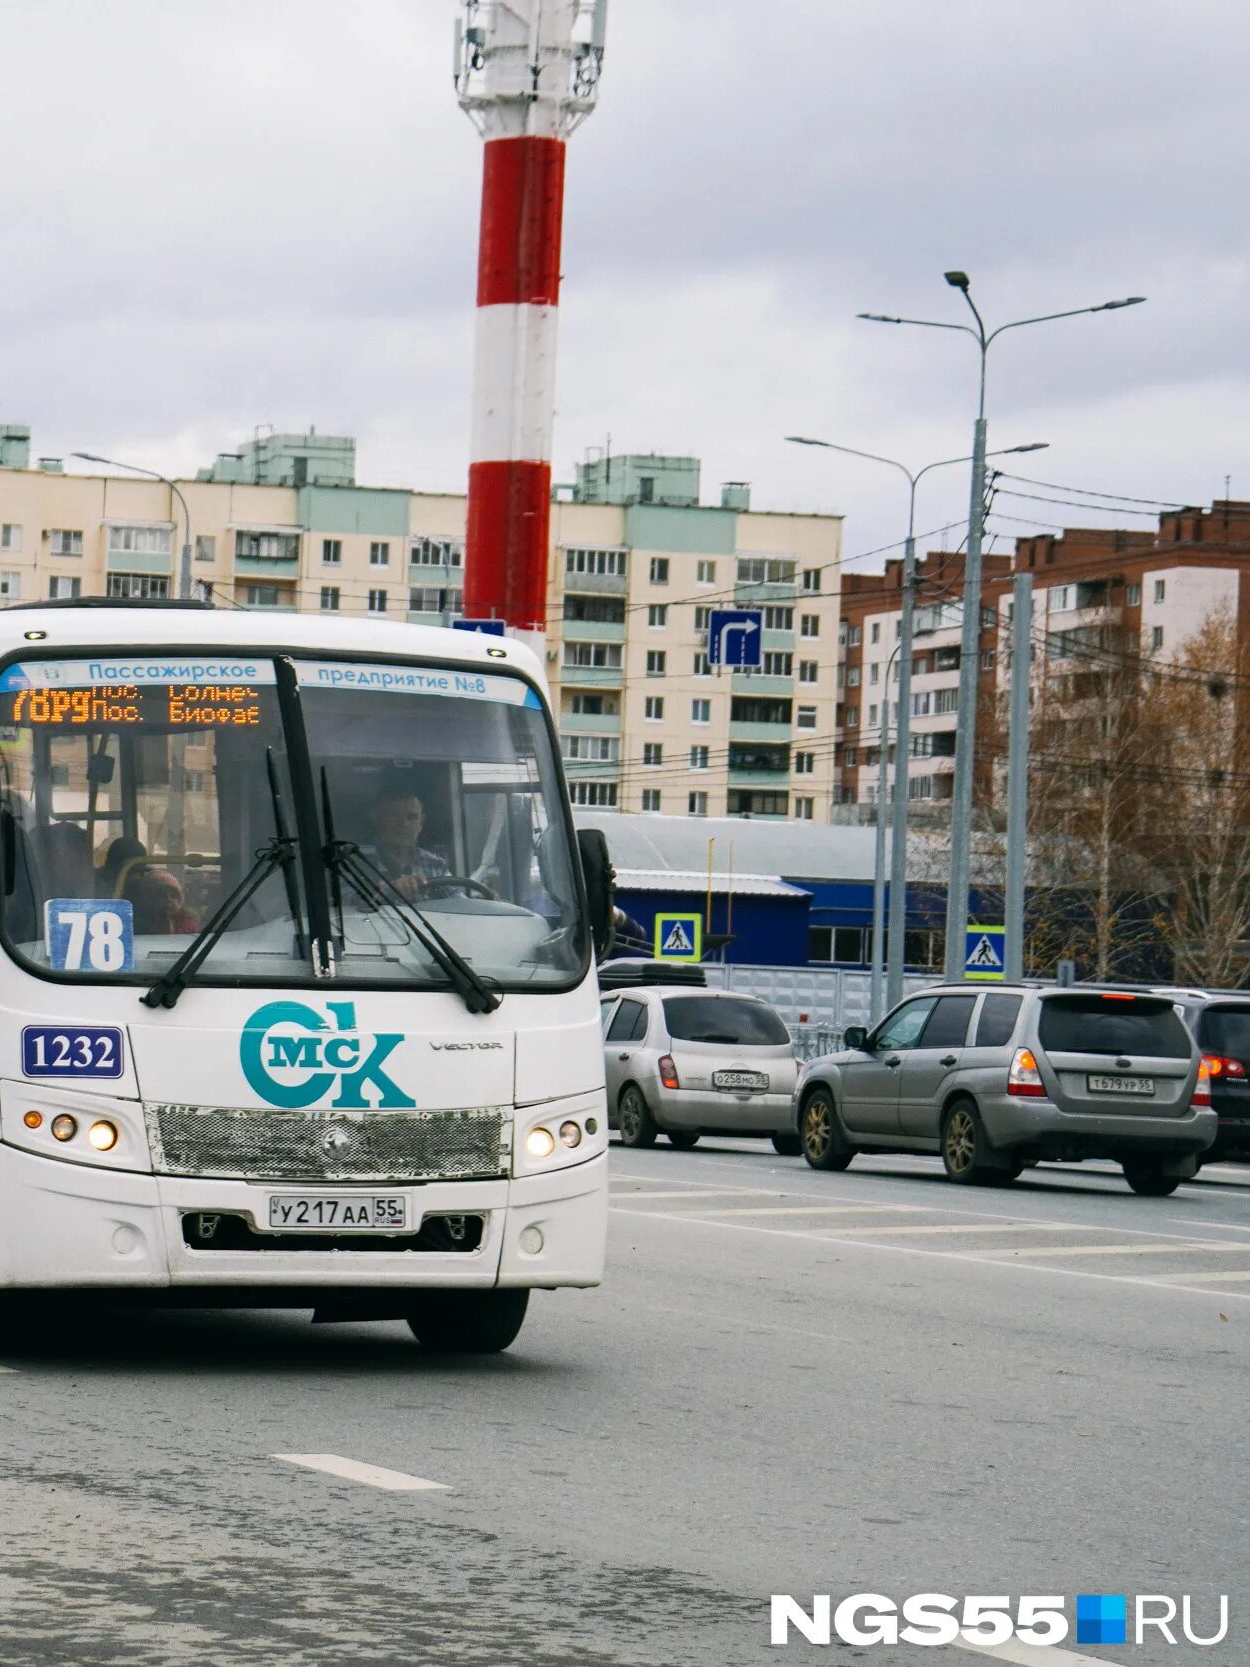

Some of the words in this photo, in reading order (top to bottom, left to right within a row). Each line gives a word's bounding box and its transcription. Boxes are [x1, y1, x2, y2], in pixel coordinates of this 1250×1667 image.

[89, 663, 257, 680] Пассажирское
[318, 669, 448, 690] предприятие
[455, 681, 486, 694] №8
[92, 700, 144, 721] Пос.
[57, 911, 125, 971] 78
[32, 1035, 115, 1068] 1232
[375, 1199, 398, 1217] 55
